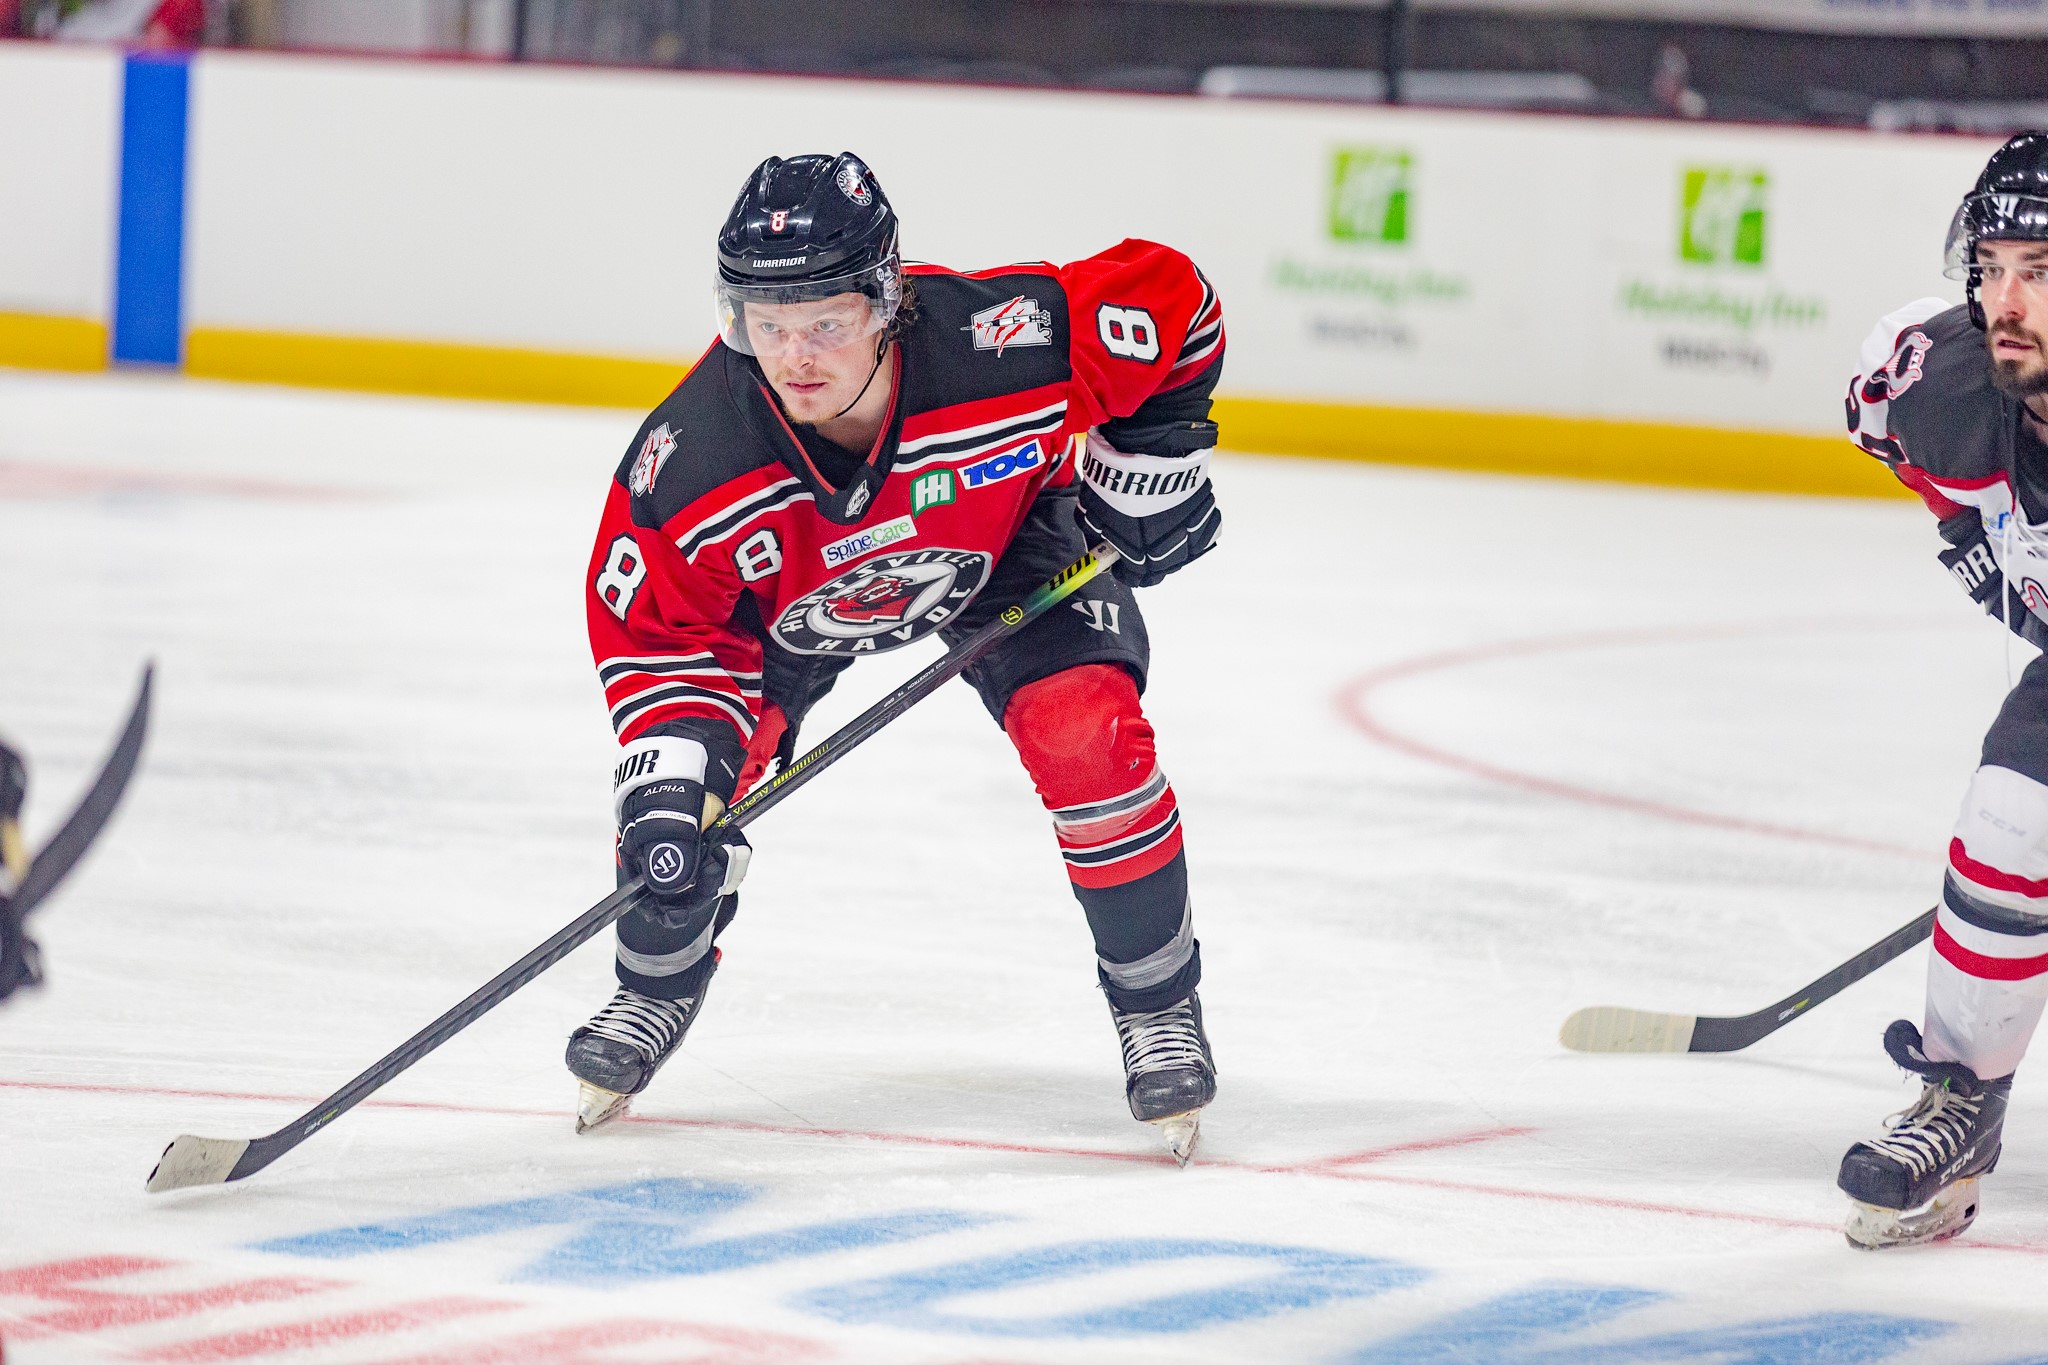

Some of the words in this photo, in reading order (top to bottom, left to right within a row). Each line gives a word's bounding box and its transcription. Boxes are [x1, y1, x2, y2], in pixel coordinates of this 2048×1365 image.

[770, 209, 787, 233] 8
[752, 256, 807, 268] WARRIOR
[1095, 301, 1161, 364] 8
[964, 442, 1039, 486] TOC
[731, 527, 782, 582] 8
[594, 531, 648, 621] 8
[781, 551, 982, 633] HUNTSVILLE
[814, 586, 972, 652] HAVOC
[642, 785, 686, 798] ALPHA
[733, 786, 769, 815] ALPHA
[1978, 808, 2027, 838] CCM
[1939, 1146, 1976, 1186] CCM
